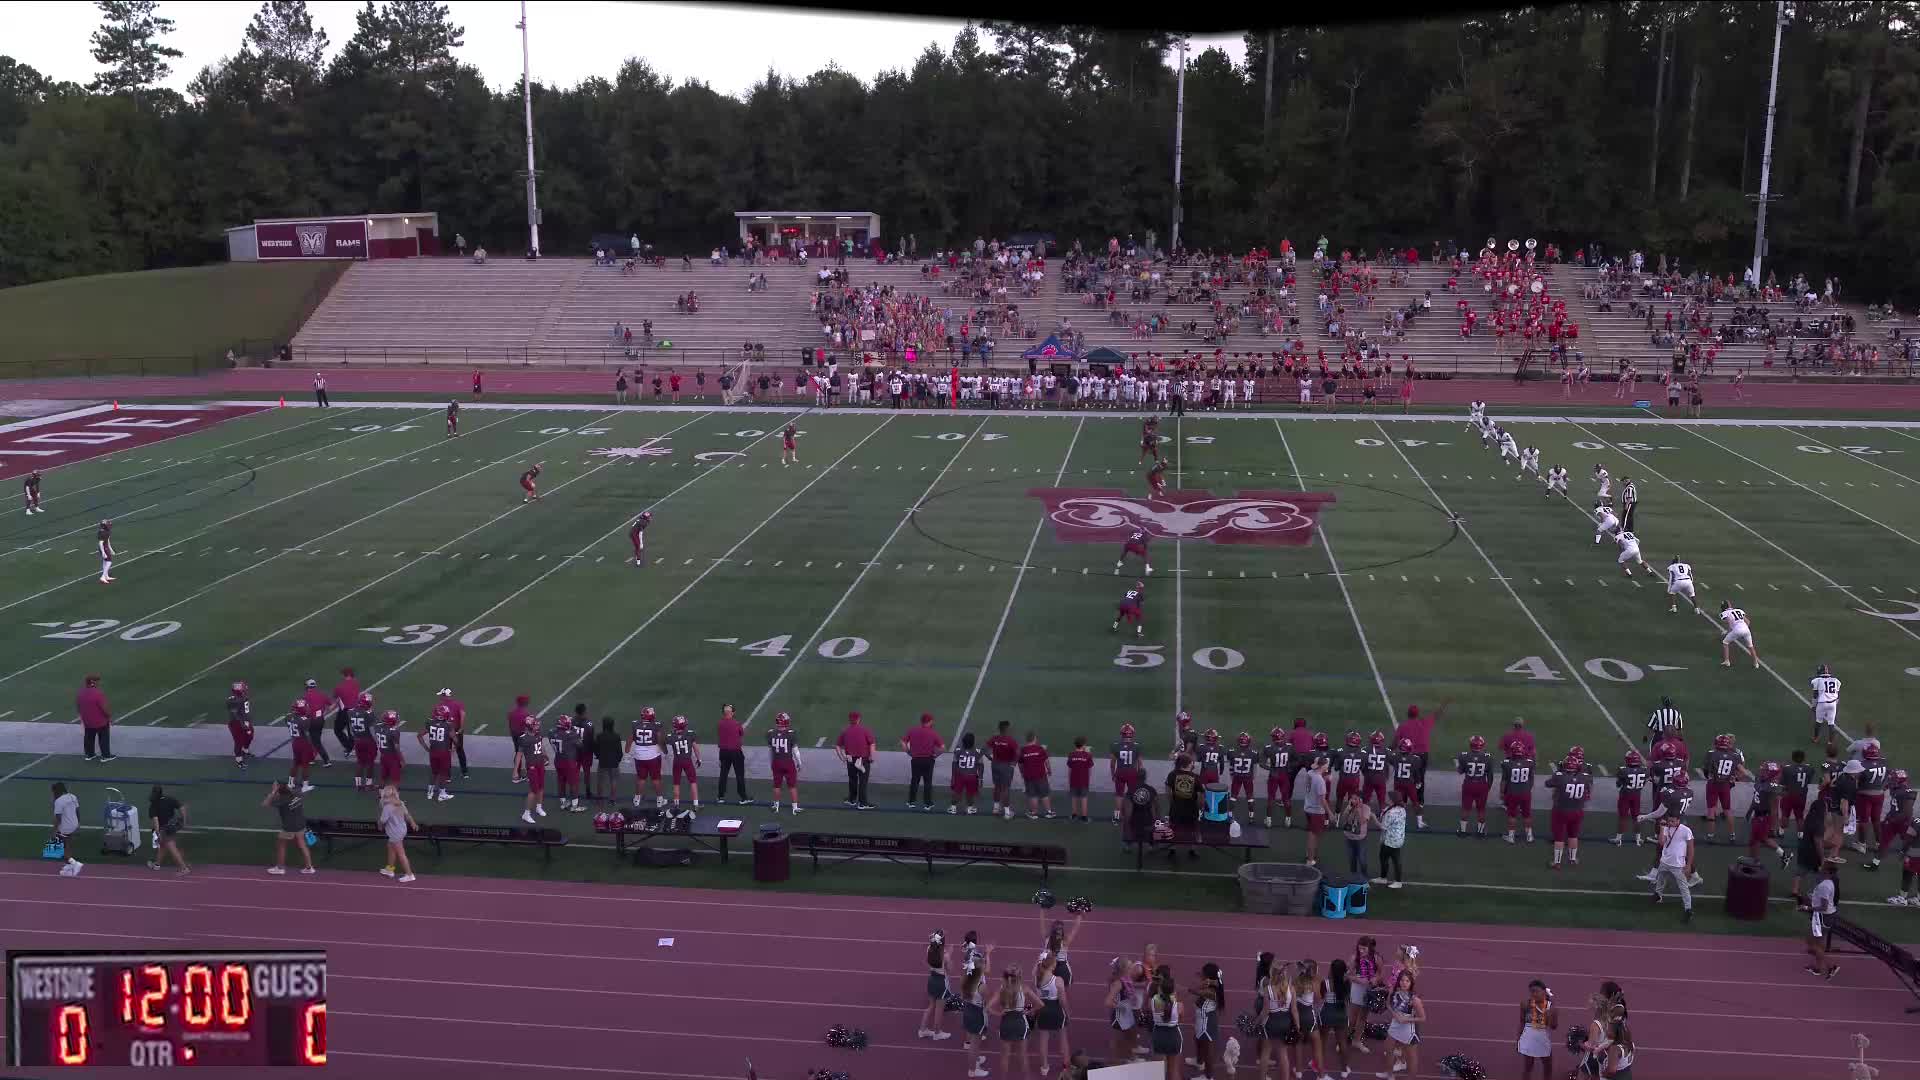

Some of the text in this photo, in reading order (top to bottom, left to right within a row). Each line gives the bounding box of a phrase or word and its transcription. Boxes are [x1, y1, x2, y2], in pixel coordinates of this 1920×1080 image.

[335, 239, 361, 247] RAMS
[1678, 565, 1685, 574] 8
[39, 618, 182, 641] 20
[382, 623, 515, 647] 30
[739, 634, 869, 659] 40
[1113, 644, 1246, 670] 50
[1503, 655, 1645, 682] 40
[1823, 681, 1836, 694] 12
[429, 725, 445, 742] 58
[636, 729, 653, 744] 52
[674, 739, 689, 755] 14
[771, 738, 787, 753] 44
[957, 754, 976, 769] 20
[1119, 750, 1133, 765] 91
[1233, 757, 1252, 774] 23
[1274, 752, 1289, 768] 10
[1367, 754, 1386, 771] 55
[1343, 758, 1362, 774] 86
[1397, 762, 1412, 779] 15
[1466, 762, 1486, 777] 33
[1717, 759, 1733, 776] 18
[1510, 767, 1530, 783] 88
[1626, 773, 1646, 790] 36
[1797, 772, 1807, 788] 4
[1868, 766, 1887, 784] 74
[1565, 783, 1585, 799] 90
